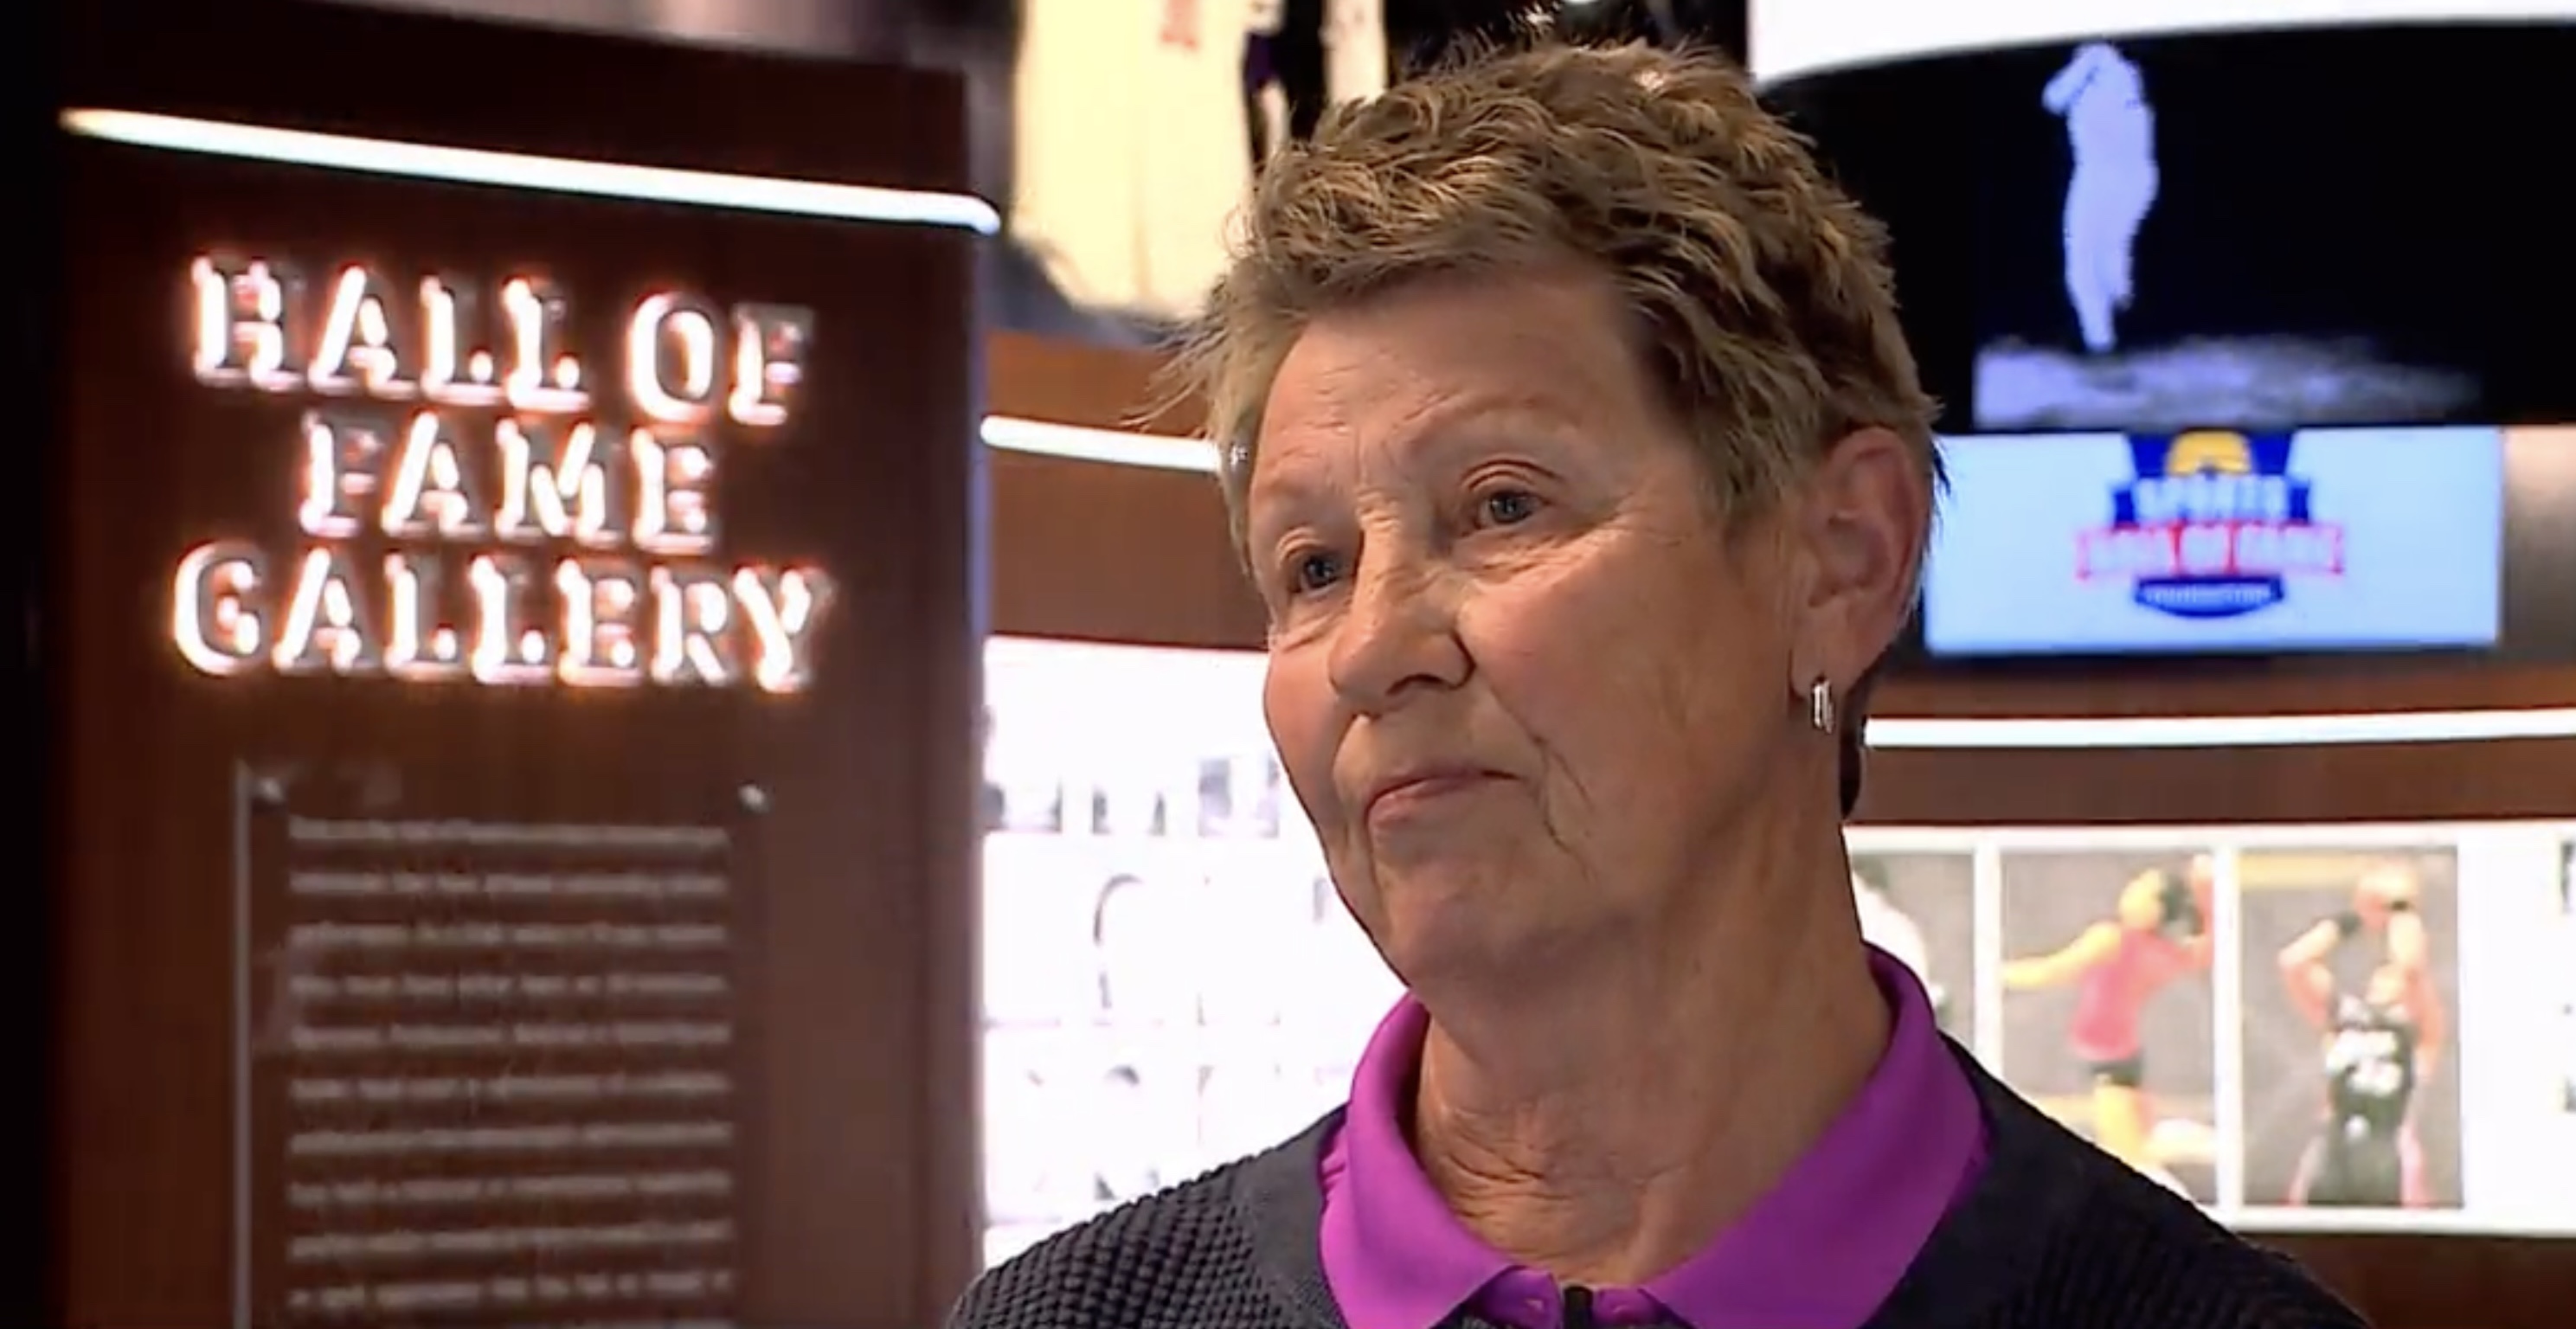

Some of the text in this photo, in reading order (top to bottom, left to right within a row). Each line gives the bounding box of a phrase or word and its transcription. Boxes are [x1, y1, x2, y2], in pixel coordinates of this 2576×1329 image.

[192, 254, 815, 425] HALL OF
[299, 410, 718, 554] FAME
[173, 541, 836, 691] GALLERY
